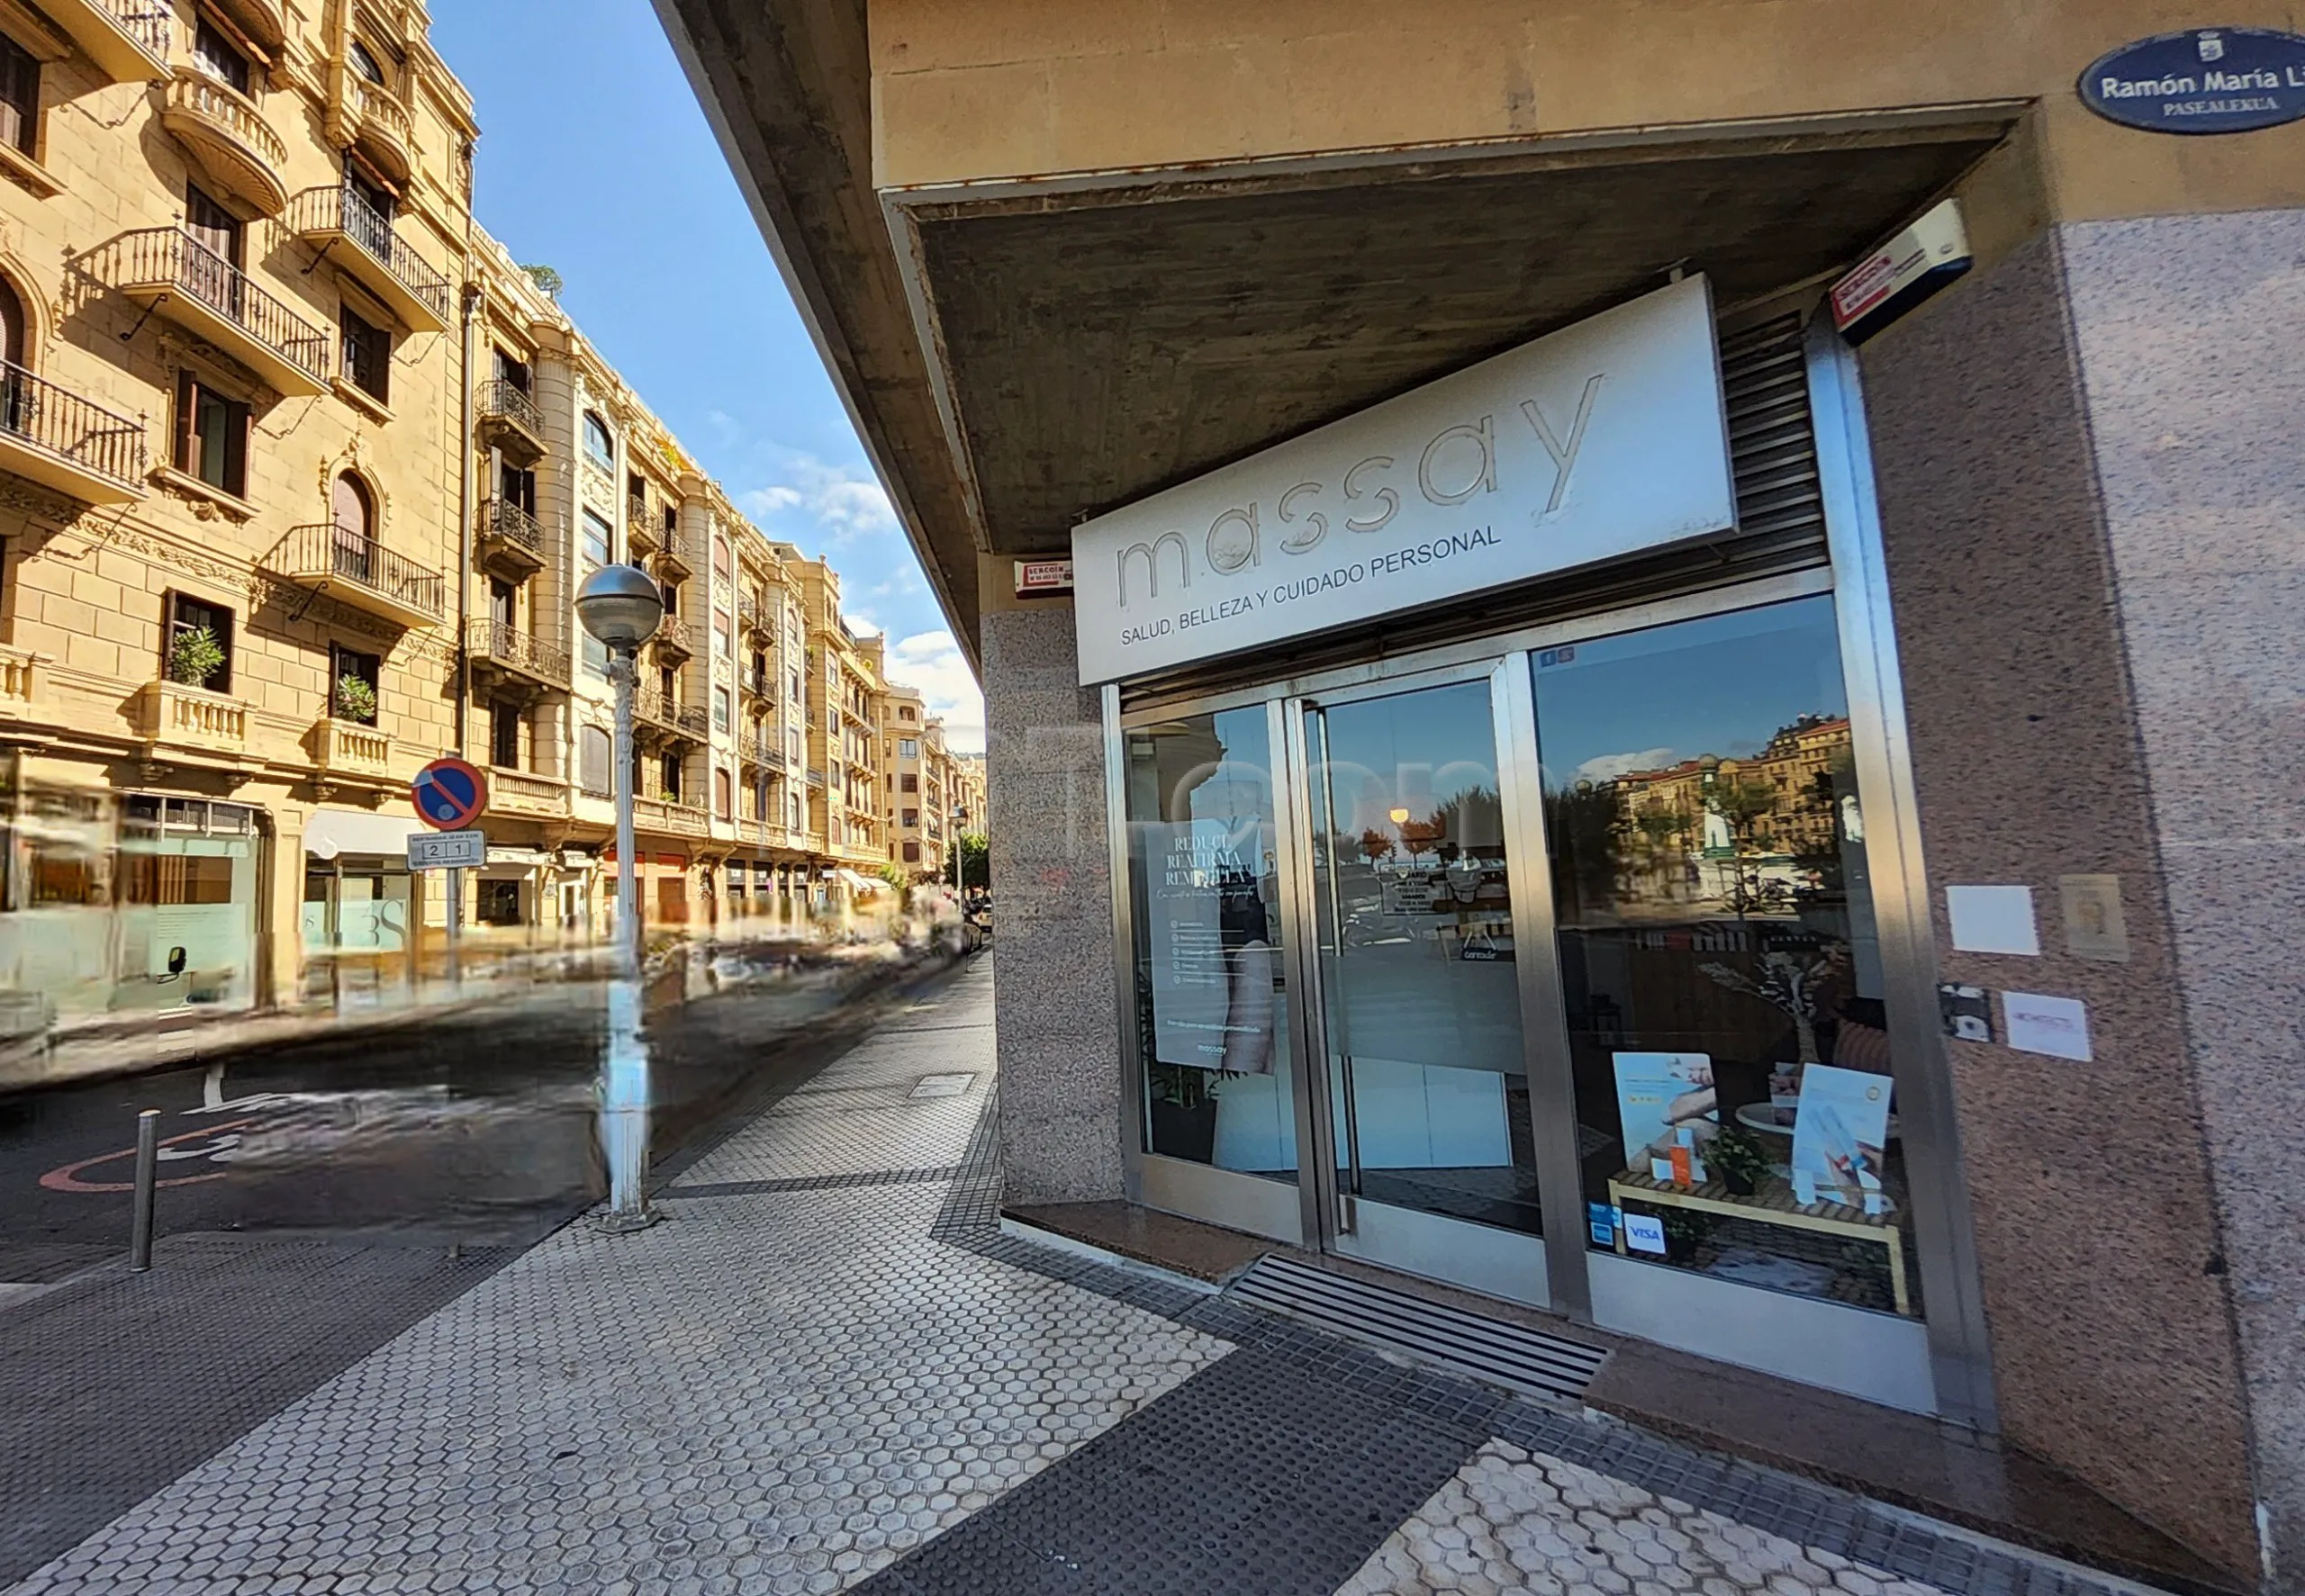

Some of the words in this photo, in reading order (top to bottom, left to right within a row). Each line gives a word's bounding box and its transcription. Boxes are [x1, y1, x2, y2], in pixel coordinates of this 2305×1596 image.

[2101, 72, 2196, 99] Ramón
[2204, 68, 2280, 92] María
[2285, 66, 2305, 87] L
[1115, 372, 1605, 609] massay
[1121, 618, 1176, 645] SALUD,
[1180, 595, 1254, 629] BELLEZA
[1256, 590, 1269, 608] Y
[1273, 564, 1365, 603] CUIDADO
[1370, 525, 1502, 577] PERSONAL
[429, 845, 438, 856] 2
[455, 843, 462, 854] 1
[1628, 1226, 1661, 1240] VISA
